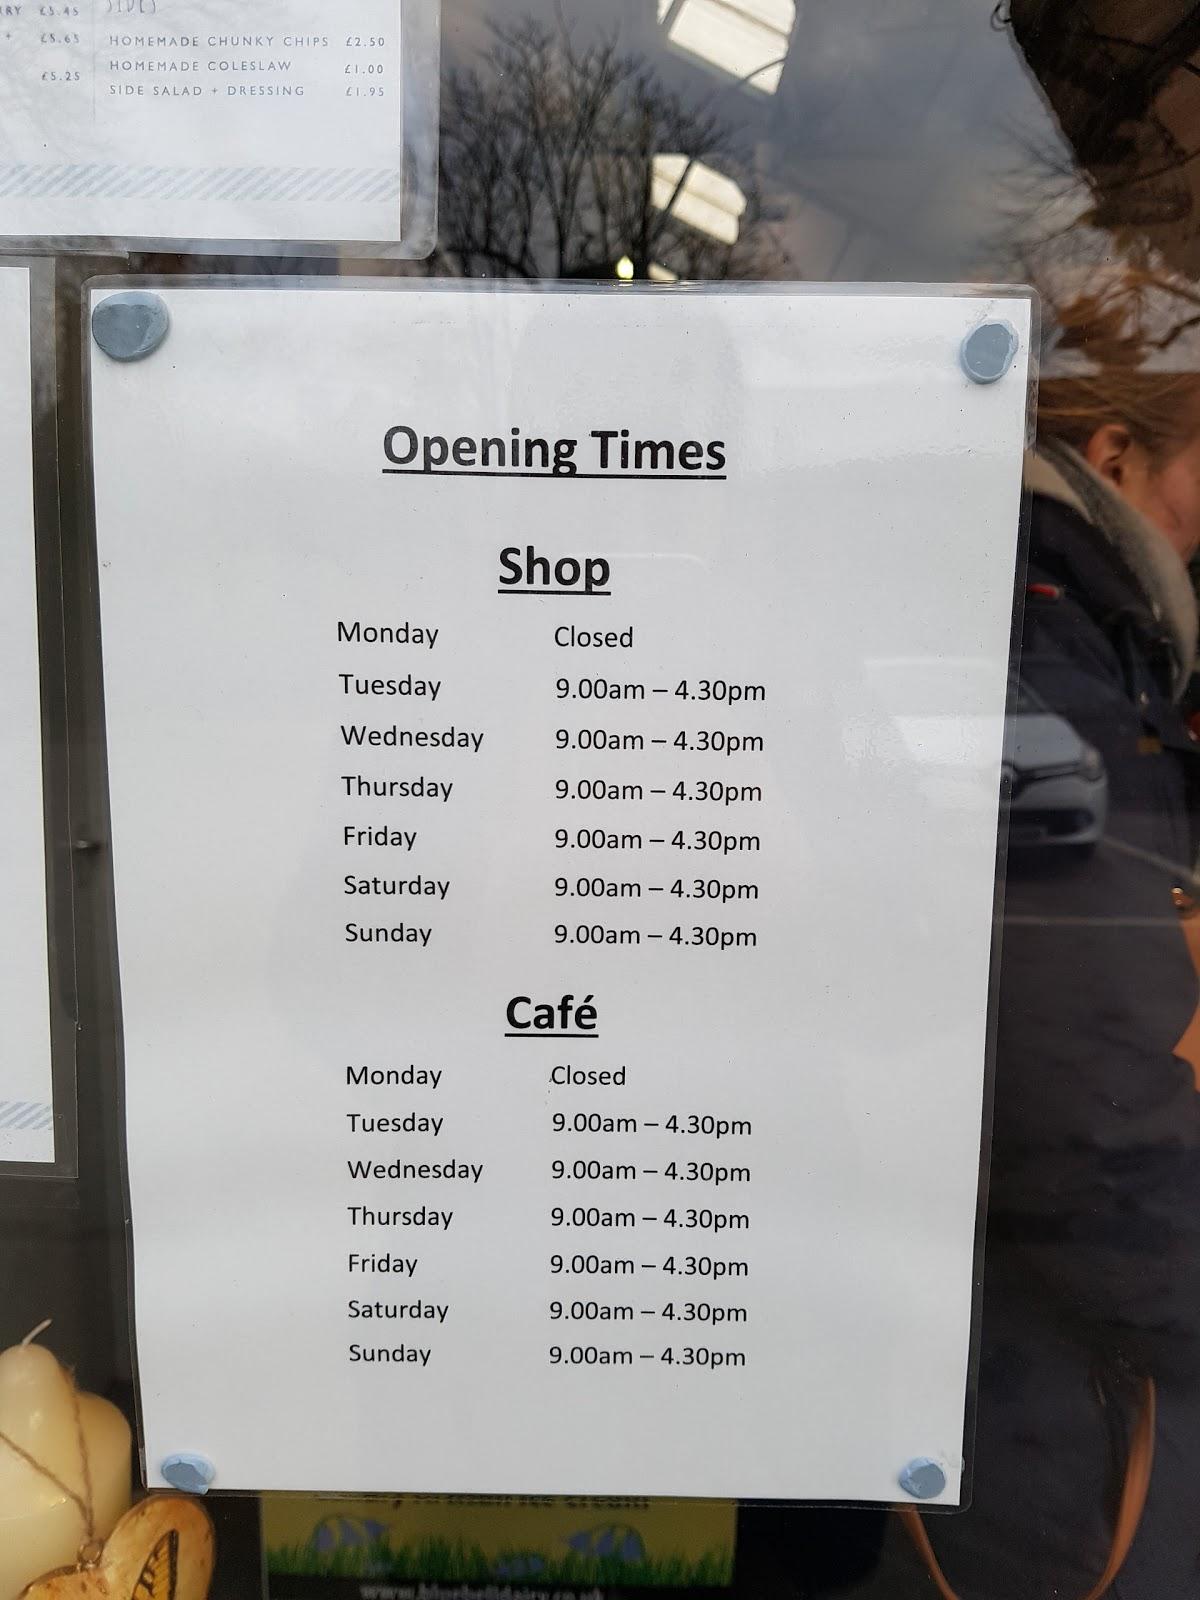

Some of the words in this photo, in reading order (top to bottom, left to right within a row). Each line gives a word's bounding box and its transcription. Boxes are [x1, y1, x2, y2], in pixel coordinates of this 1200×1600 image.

[0, 6, 22, 16] RY
[40, 33, 81, 44] £5.65
[109, 35, 200, 48] HOMEMADE
[207, 36, 274, 48] CHUNKY
[283, 36, 329, 48] CHIPS
[345, 36, 386, 47] £2.50
[41, 71, 81, 82] £5.25
[109, 60, 200, 72] HOMEMADE
[207, 60, 292, 72] COLESLAW
[344, 64, 385, 75] £1.00
[109, 84, 145, 96] SIDE
[153, 85, 203, 97] SALAD
[227, 85, 305, 97] DRESSING
[345, 86, 385, 97] £1.95
[382, 425, 578, 475] Opening
[589, 429, 727, 471] Times
[498, 544, 611, 594] Shop
[337, 620, 440, 650] Monday
[554, 624, 634, 649] Closed
[338, 673, 442, 702] Tuesday
[555, 677, 645, 700] 9.00am
[674, 679, 766, 706] 4.30pm
[339, 724, 485, 753] Wednesday
[554, 728, 644, 751] 9.00am
[672, 730, 764, 757] 4.30pm
[340, 774, 454, 803] Thursday
[555, 779, 644, 801] 9.00am
[671, 780, 762, 807] 4.30pm
[343, 824, 418, 852] Friday
[554, 828, 643, 850] 9.00am
[670, 829, 761, 856] 4.30pm
[343, 874, 451, 901] Saturday
[554, 876, 642, 898] 9.00am
[669, 878, 759, 904] 4.30pm
[345, 922, 433, 948] Sunday
[554, 924, 641, 945] 9.00am
[668, 926, 757, 951] 4.30pm
[505, 993, 599, 1030] Café
[346, 1064, 443, 1090] Monday
[550, 1064, 626, 1086] Closed
[345, 1111, 444, 1137] Tuesday
[552, 1112, 638, 1134] 9.00am
[664, 1114, 752, 1140] 4.30pm
[346, 1158, 484, 1184] Wednesday
[551, 1159, 637, 1181] 9.00am
[663, 1161, 751, 1187] 4.30pm
[346, 1205, 454, 1231] Thursday
[550, 1206, 636, 1228] 9.00am
[662, 1208, 750, 1234] 4.30pm
[348, 1252, 419, 1278] Friday
[549, 1254, 635, 1275] 9.00am
[662, 1255, 749, 1281] 4.30pm
[347, 1299, 450, 1324] Saturday
[549, 1300, 634, 1321] 9.00am
[661, 1302, 748, 1327] 4.30pm
[348, 1343, 432, 1368] Sunday
[549, 1345, 633, 1365] 9.00am
[660, 1346, 746, 1371] 4.30pm
